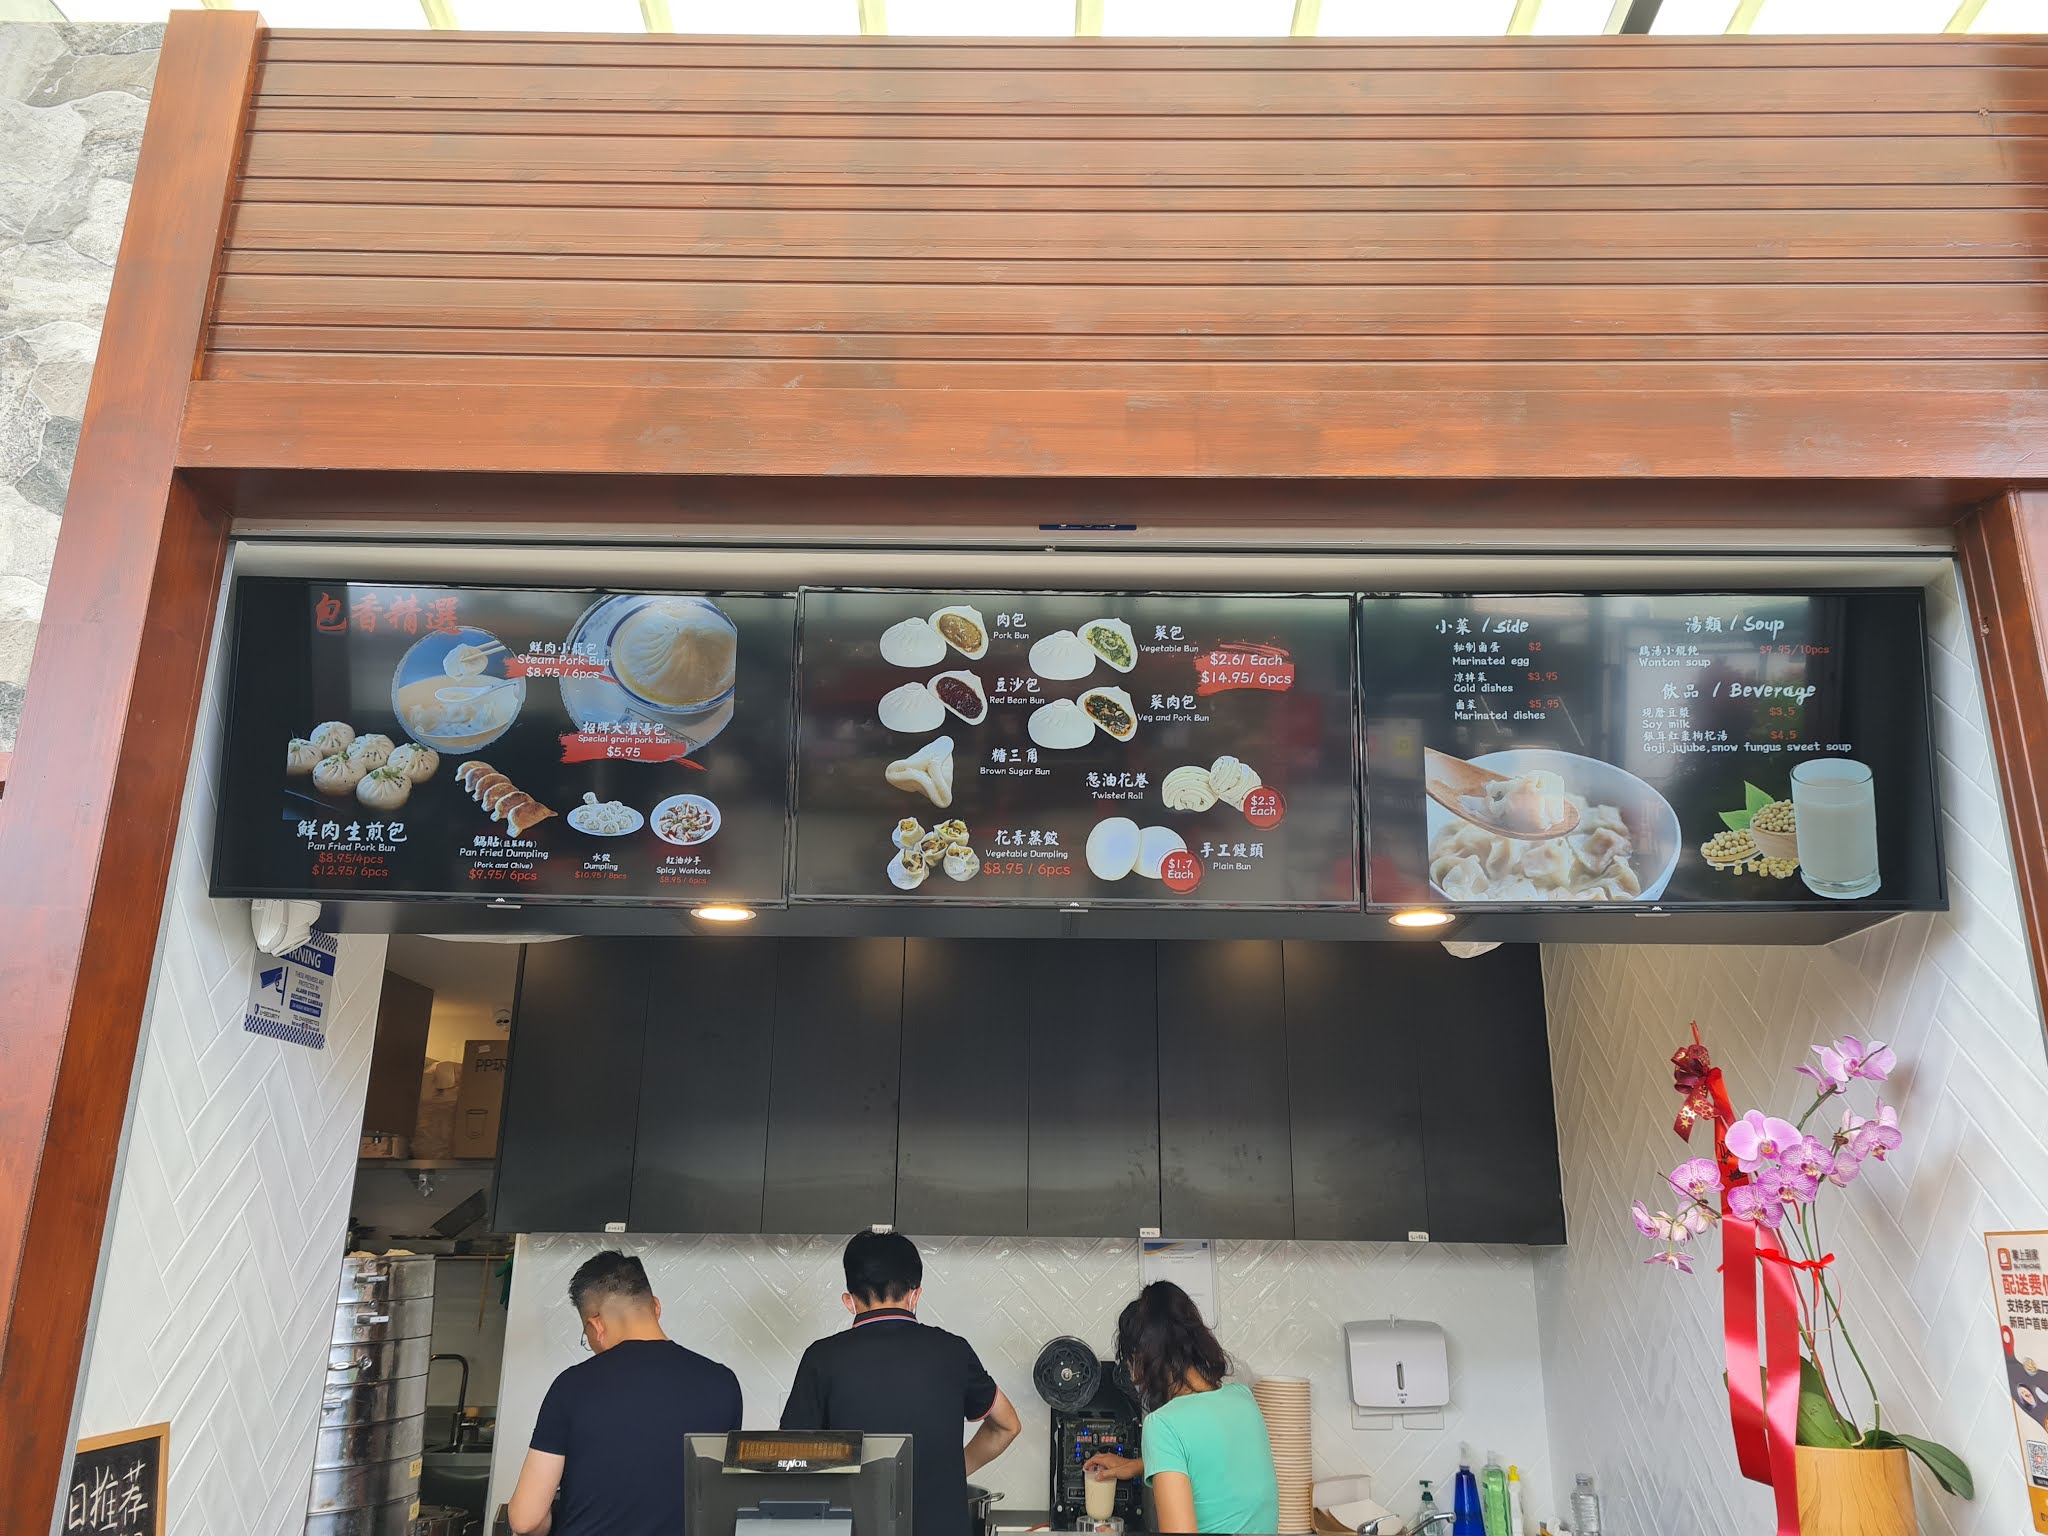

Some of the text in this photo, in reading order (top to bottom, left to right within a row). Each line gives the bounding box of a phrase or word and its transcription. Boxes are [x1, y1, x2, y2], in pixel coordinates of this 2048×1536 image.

[314, 592, 462, 635] 包香精選
[997, 612, 1027, 628] 肉包
[1435, 618, 1472, 635] 小菜
[1482, 616, 1491, 633] /
[1685, 614, 1784, 640] 湯類 / Soup
[1153, 625, 1185, 641] 菜包
[1139, 644, 1199, 654] Vegetable Bun
[1528, 642, 1542, 651] $2
[1760, 645, 1830, 656] $9.95/10pcs
[517, 654, 610, 667] Steam Pork Bun
[1210, 652, 1283, 667] $2.6/ Each
[1452, 656, 1530, 667] Marinated egg
[1639, 658, 1711, 668] Wonton soup
[525, 666, 560, 679] $8.95
[572, 668, 600, 680] 6pcs
[1201, 670, 1292, 686] $14.95/ 6pcs
[1527, 671, 1558, 682] $3.95
[995, 677, 1040, 693] 豆沙包
[1453, 683, 1514, 693] Cold dishes
[1661, 681, 1816, 705] 飲品 / Beverage
[989, 696, 1045, 704] Red Bean Bun
[1149, 694, 1197, 711] 菜肉包
[1528, 699, 1560, 710] $5.95
[1454, 711, 1546, 720] Marinated dishes
[1769, 707, 1795, 717] $3.5
[1137, 713, 1153, 723] Veg
[1173, 714, 1192, 722] Pork
[1194, 714, 1210, 722] Bun
[1642, 719, 1690, 730] Soy milk
[577, 734, 671, 745] Special grain pork bun
[1770, 730, 1797, 740] $4.5
[606, 746, 641, 758] $5.95
[1743, 742, 1781, 753] fungus
[1787, 743, 1821, 751] sweet
[1826, 743, 1852, 752] soup
[991, 748, 1039, 764] 糖三角
[979, 767, 1051, 776] Brown Sugar Bun
[1091, 791, 1144, 800] Twisted Roll
[1250, 795, 1276, 807] $2.3
[1250, 806, 1276, 816] Each
[296, 819, 408, 842] 鮮肉生煎包
[994, 829, 1060, 846] 花素蒸餃
[307, 842, 396, 852] Pan Fried Pork Bun
[318, 852, 384, 865] $8.95/4pcs
[459, 847, 549, 860] Pan Fried Dumpling
[985, 849, 1069, 860] Vegetable Dumpling
[474, 861, 493, 869] (Pork
[510, 862, 533, 870] Chive)
[583, 862, 618, 871] Dumpling
[983, 861, 1024, 876] $8.95
[1037, 863, 1071, 878] 6pcs
[1168, 858, 1193, 870] $1.7
[1213, 862, 1252, 871] Plain Bun
[312, 864, 388, 878] $12.95/ 6pcs
[469, 868, 538, 882] $9.95/ 6pcs
[574, 870, 601, 879] $10.95
[656, 866, 711, 875] Spicy Wontons
[1167, 869, 1194, 879] Each
[659, 875, 682, 884] $8.95
[688, 877, 707, 885] 6pcs
[777, 1459, 808, 1471] SENOR
[69, 1459, 148, 1531] 日推荐
